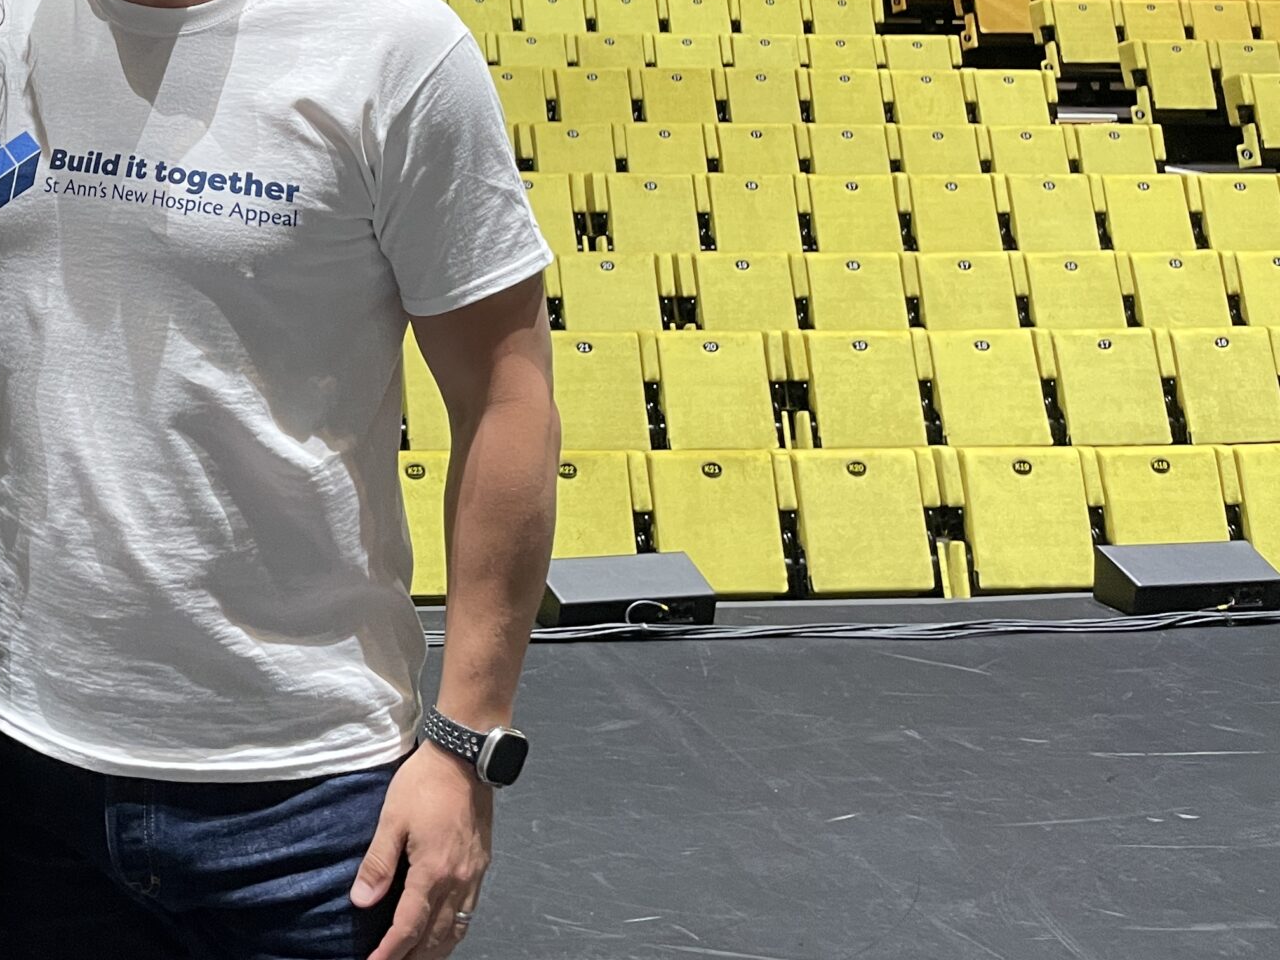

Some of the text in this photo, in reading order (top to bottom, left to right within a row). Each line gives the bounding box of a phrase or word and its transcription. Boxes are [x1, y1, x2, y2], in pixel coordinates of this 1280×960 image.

[49, 148, 300, 203] Build it together
[43, 176, 299, 228] St Ann's New Hospice Appeal
[578, 342, 591, 352] 21
[704, 342, 717, 352] 20
[854, 341, 866, 350] 19
[976, 341, 988, 350] 18
[1099, 340, 1110, 349] 17
[1216, 338, 1228, 347] 16
[560, 465, 575, 474] K22
[704, 464, 720, 474] K21
[848, 463, 865, 473] K20
[1014, 462, 1030, 472] K19
[1153, 460, 1168, 470] K18
[407, 466, 424, 475] K23
